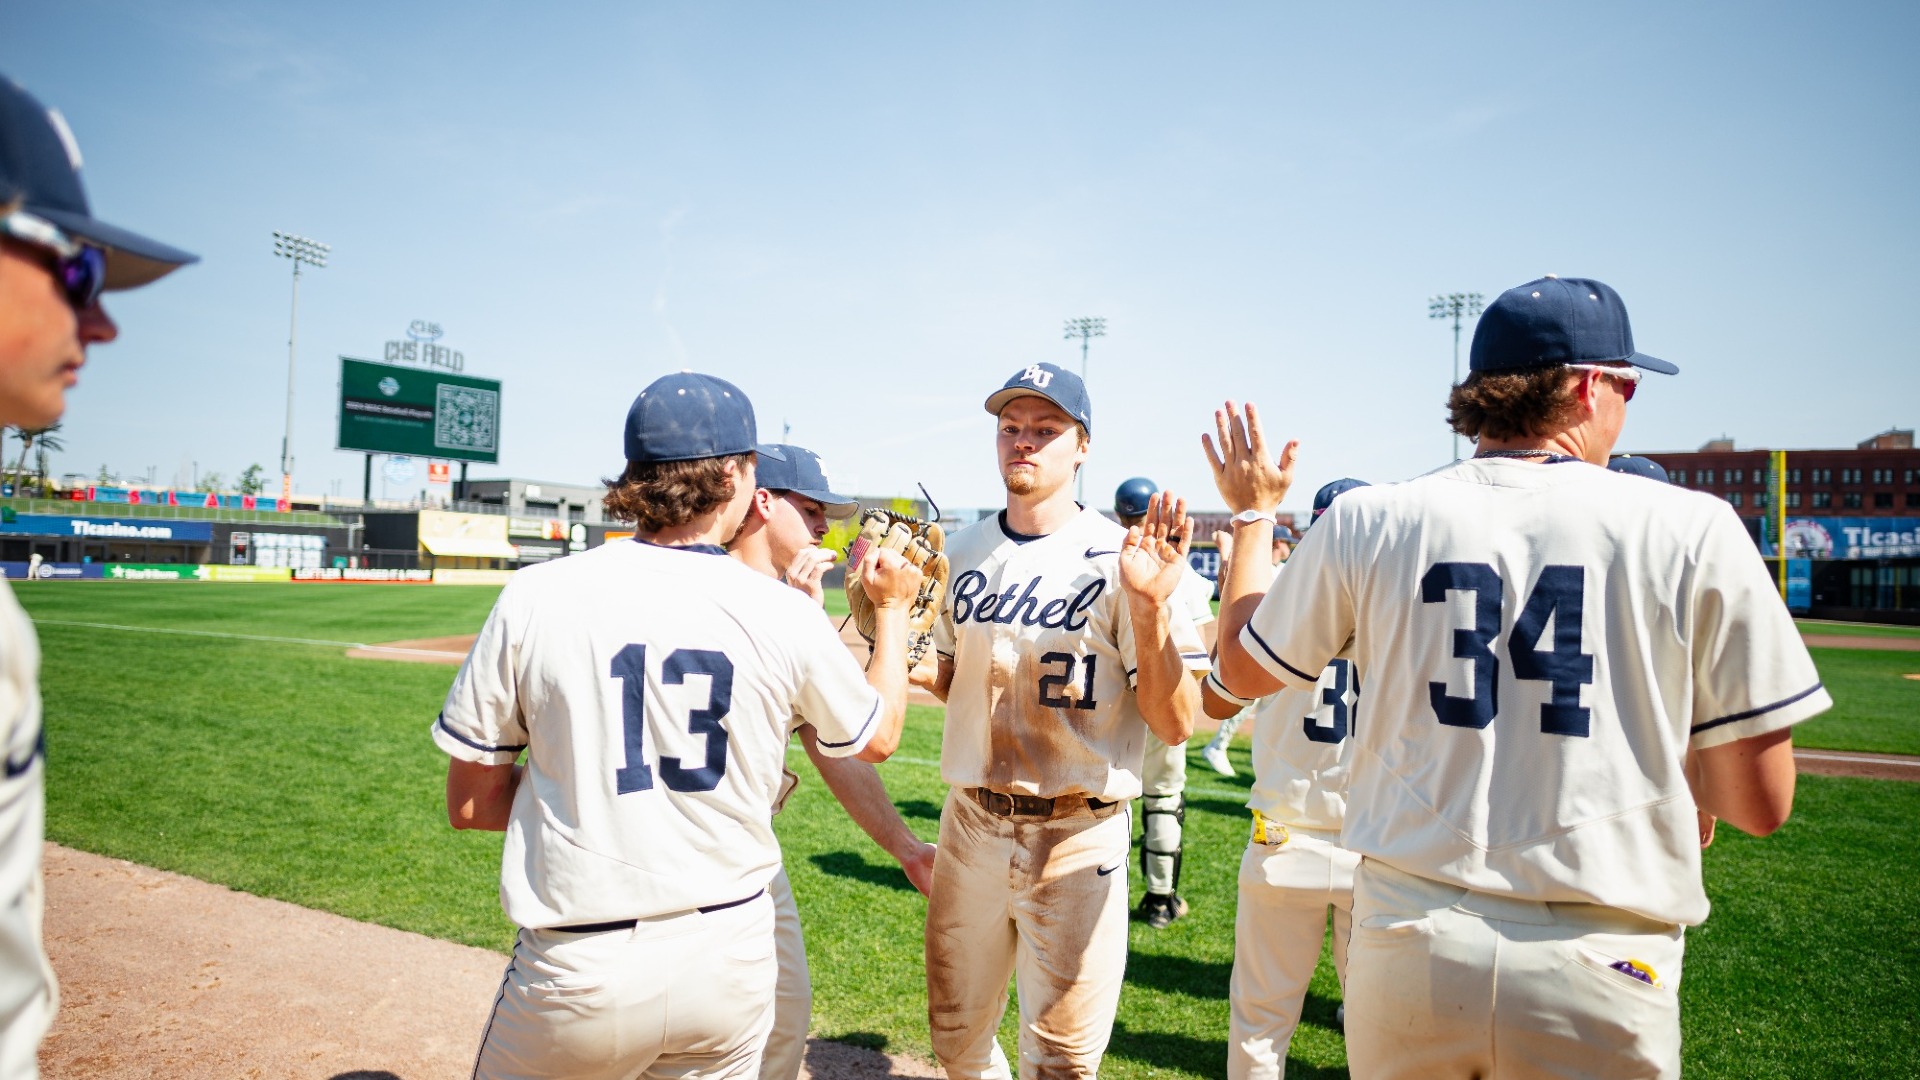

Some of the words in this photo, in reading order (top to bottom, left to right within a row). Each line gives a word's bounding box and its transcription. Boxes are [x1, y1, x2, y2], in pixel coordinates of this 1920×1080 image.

[384, 340, 418, 361] CHS
[422, 343, 464, 372] FIELD
[1020, 364, 1053, 388] BU
[953, 570, 1106, 631] Bethel
[1422, 562, 1593, 738] 34
[1039, 652, 1097, 710] 21
[610, 643, 733, 795] 13
